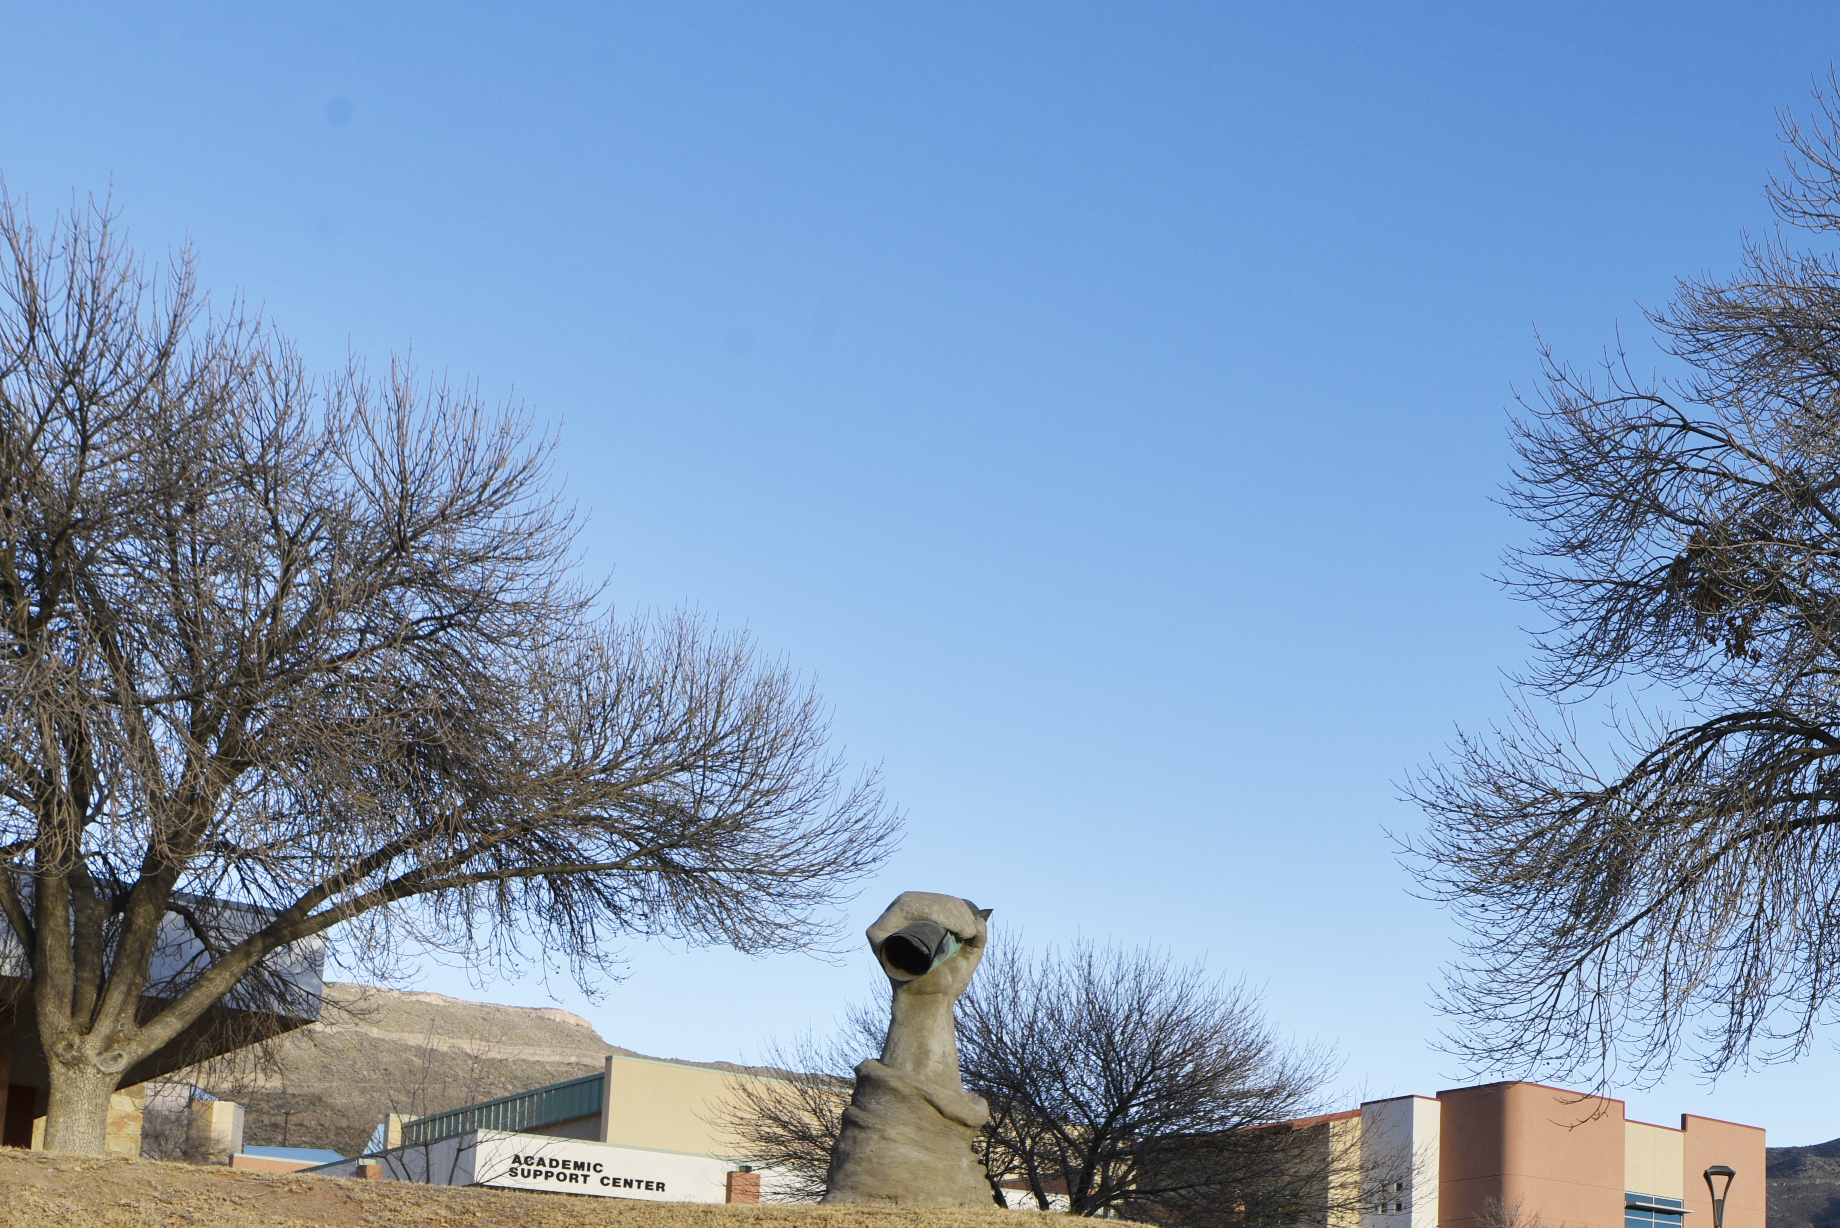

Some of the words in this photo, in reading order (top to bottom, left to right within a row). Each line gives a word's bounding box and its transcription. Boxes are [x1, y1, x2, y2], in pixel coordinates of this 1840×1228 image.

[511, 1154, 604, 1173] ACADEMIC
[508, 1167, 591, 1184] SUPPORT
[599, 1176, 666, 1192] CENTER
